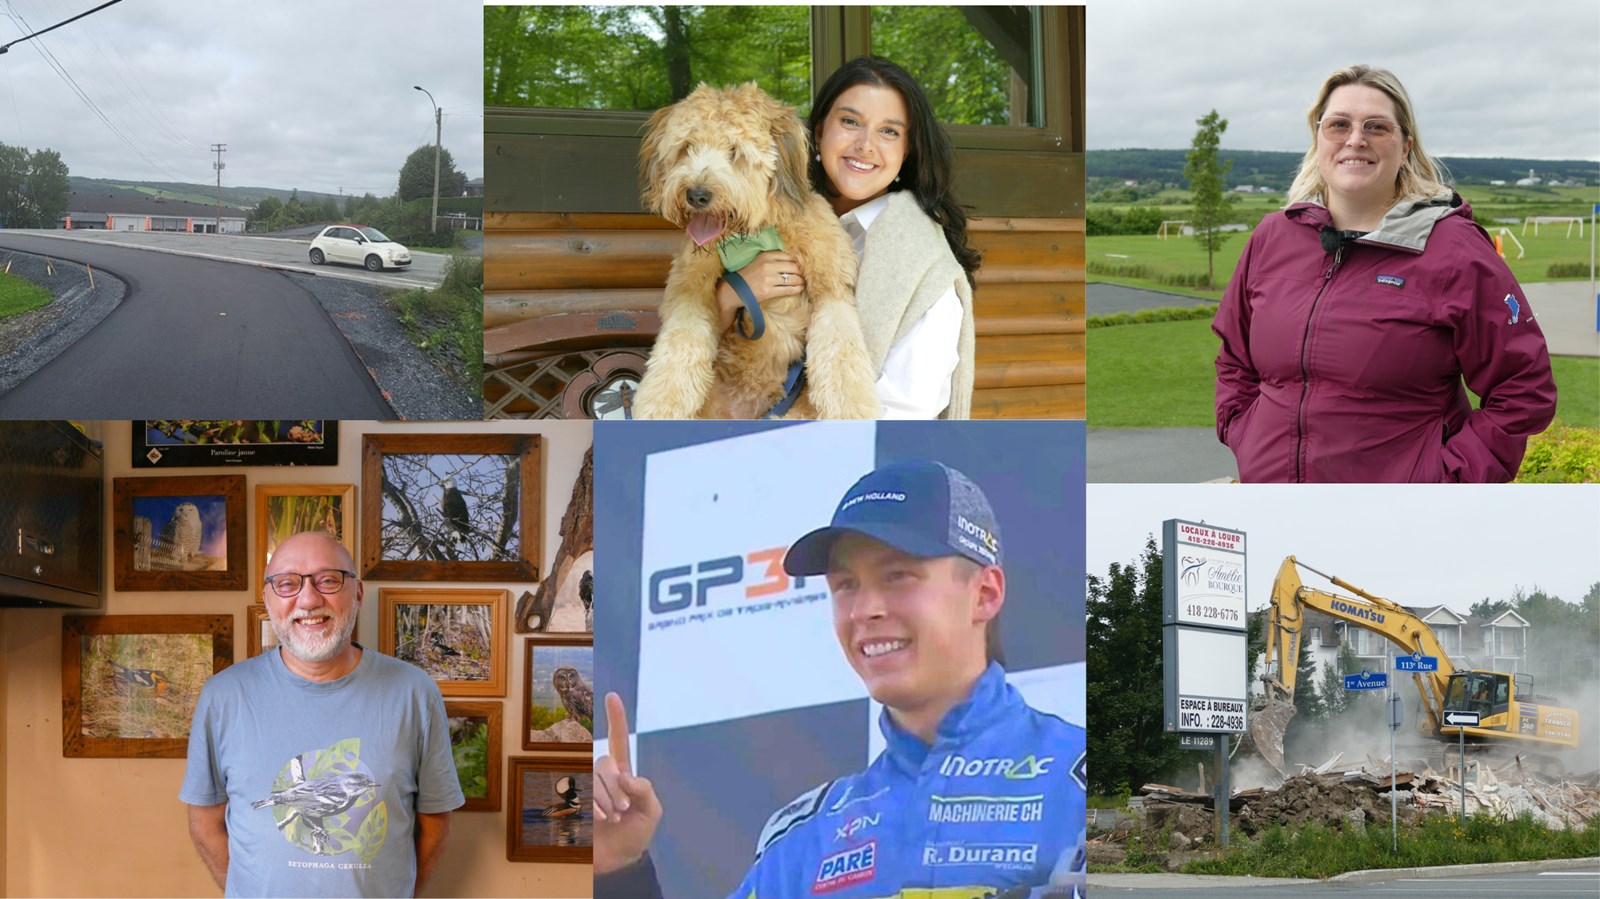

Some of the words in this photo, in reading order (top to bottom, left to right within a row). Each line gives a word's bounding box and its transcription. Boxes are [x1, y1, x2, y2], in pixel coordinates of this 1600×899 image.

[210, 449, 237, 457] Paruline
[865, 493, 906, 501] HOLLAND
[957, 515, 998, 552] INOTRAC
[1181, 525, 1209, 536] LOCAUX
[1218, 532, 1240, 543] LOUER
[1187, 536, 1234, 549] 418-228-4936
[649, 546, 806, 614] GP3
[1208, 581, 1243, 594] BOURQUE
[1187, 604, 1201, 616] 418
[1204, 606, 1238, 621] 228-6776
[1330, 599, 1385, 624] KOMATSU
[1417, 661, 1433, 670] Rue
[1357, 680, 1386, 688] Avenue
[1180, 699, 1206, 710] ESPACE
[1213, 701, 1244, 713] BUREAUX
[1181, 712, 1203, 727] INFO.
[1211, 714, 1244, 729] 228-4936
[1181, 736, 1191, 745] LE
[1193, 737, 1214, 746] 11289
[939, 755, 1055, 779] INOTRAC
[929, 803, 1018, 823] MACHINERIE
[1020, 802, 1043, 821] CH
[833, 812, 881, 843] XPN
[923, 847, 943, 865] R.
[948, 844, 1038, 863] Durand
[288, 861, 335, 869] SETOPHAGA
